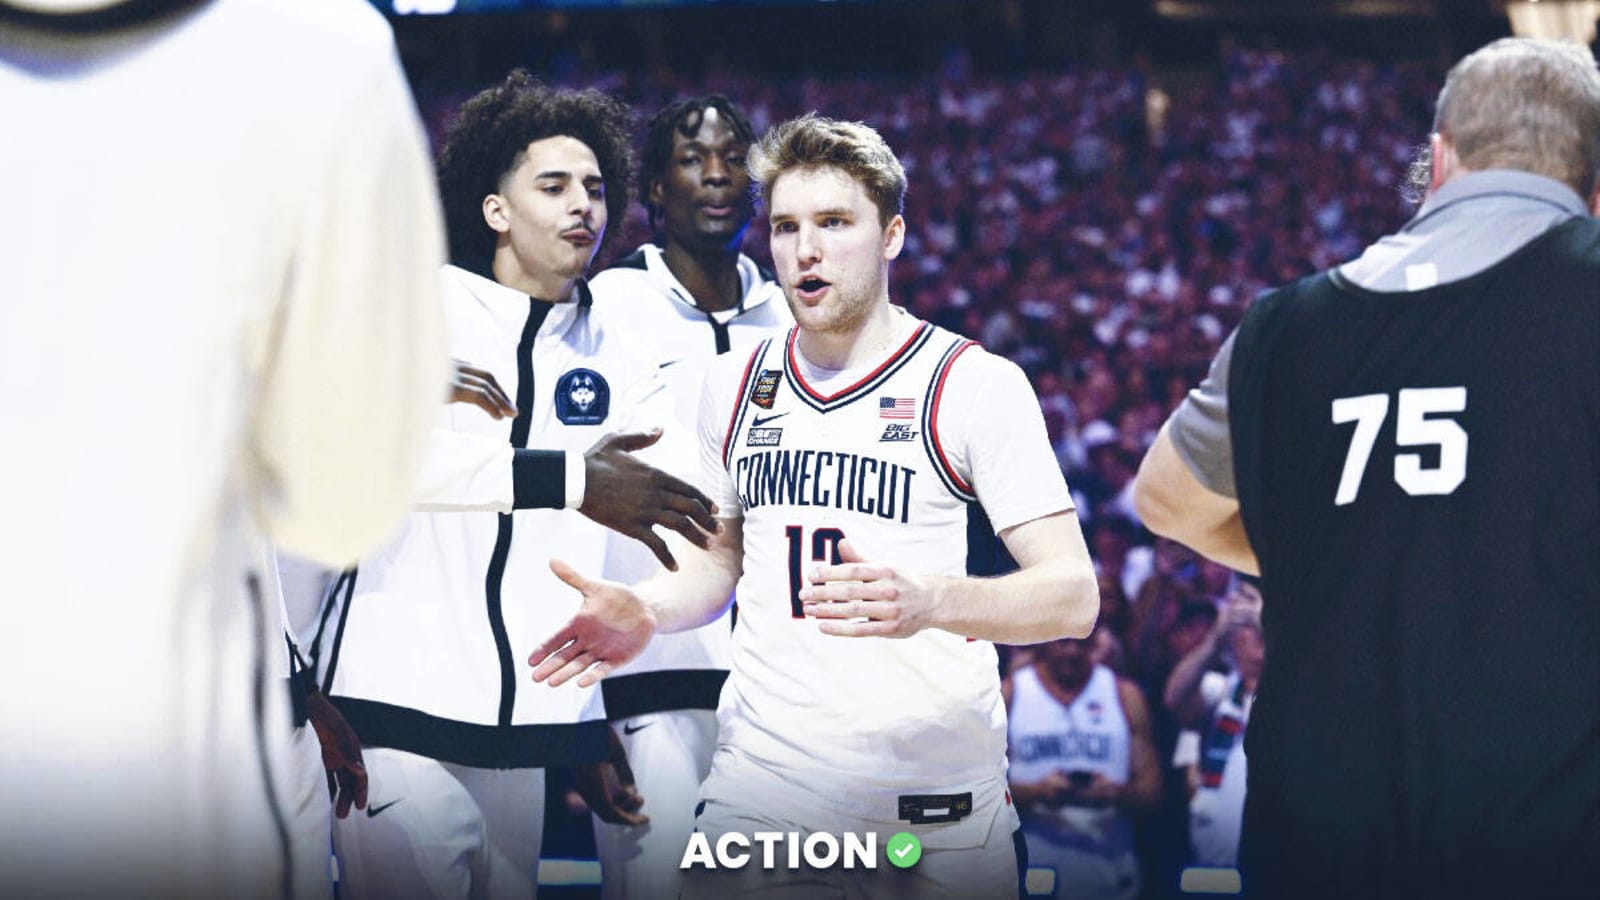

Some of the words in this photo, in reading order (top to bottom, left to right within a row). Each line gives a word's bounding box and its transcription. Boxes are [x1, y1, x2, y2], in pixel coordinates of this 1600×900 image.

[881, 432, 919, 440] EAST
[886, 423, 912, 431] BIG
[1332, 386, 1469, 506] 75
[737, 450, 917, 523] CONNECTICUT
